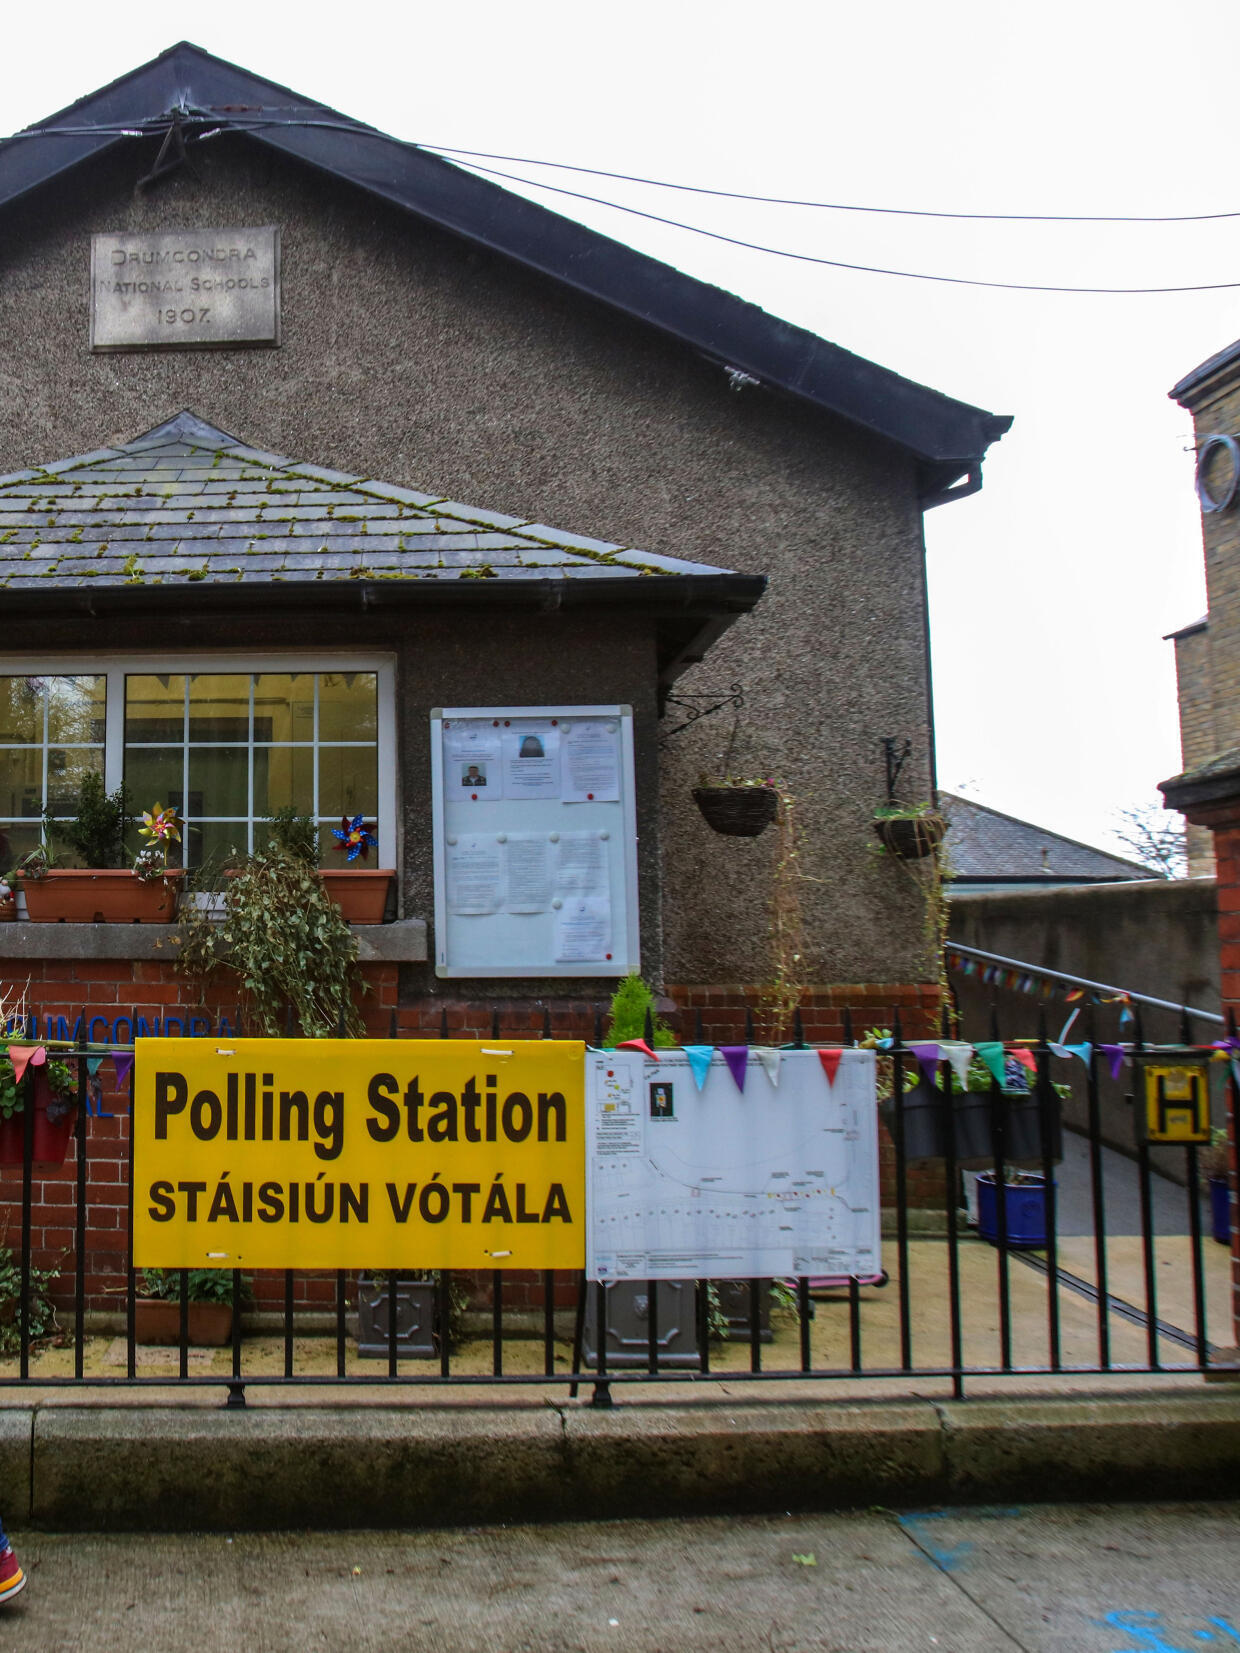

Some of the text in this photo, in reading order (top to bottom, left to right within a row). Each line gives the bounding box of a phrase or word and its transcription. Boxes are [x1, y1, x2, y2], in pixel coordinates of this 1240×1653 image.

[111, 248, 258, 266] DRUMCONDRA
[100, 276, 271, 295] NATIONAL SCHOOLS
[155, 1072, 345, 1160] Polling
[366, 1073, 567, 1143] Station
[1157, 1074, 1199, 1134] H
[148, 1171, 573, 1224] STÁISIÚN VÓTÁLA
